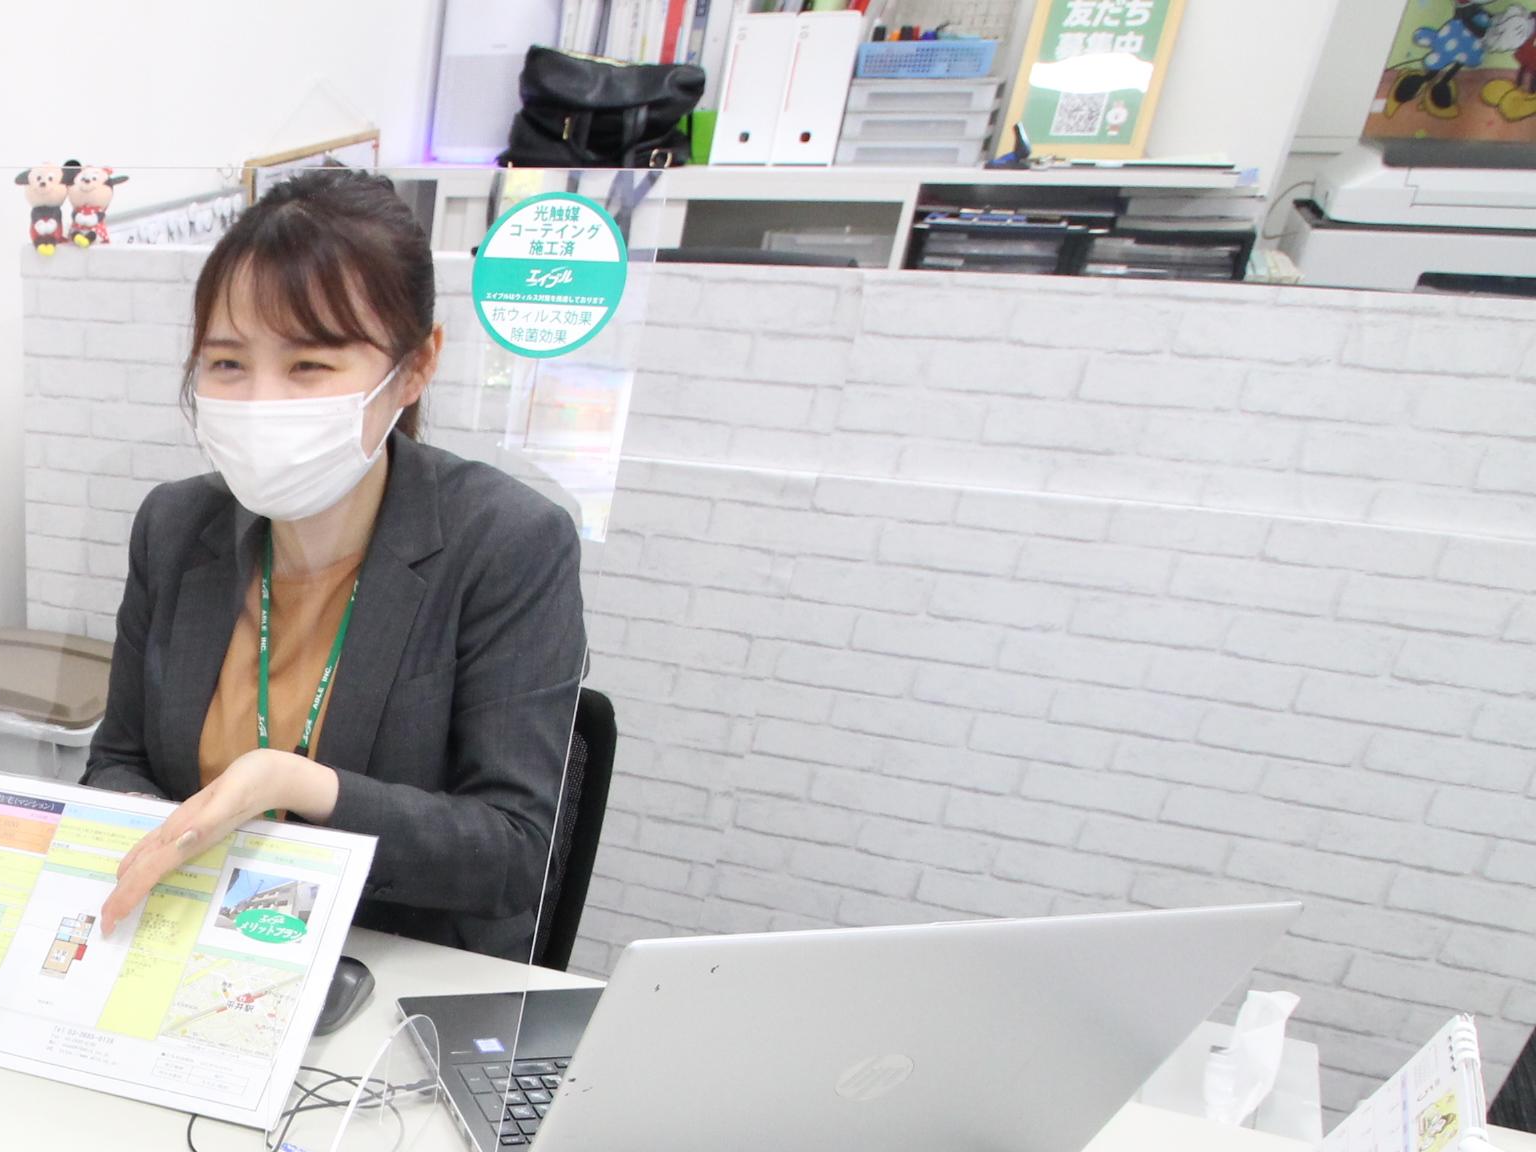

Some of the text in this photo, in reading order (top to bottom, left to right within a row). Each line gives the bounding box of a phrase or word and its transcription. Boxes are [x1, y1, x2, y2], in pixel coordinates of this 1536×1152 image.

[1062, 0, 1153, 27] 友だち
[533, 205, 581, 223] 光触媒
[528, 240, 576, 257] 施工済
[525, 266, 574, 288] エイブル
[492, 306, 593, 327] 抗ウィルス効果
[510, 327, 568, 345] 除菌効果
[239, 921, 303, 940] メリットプラン
